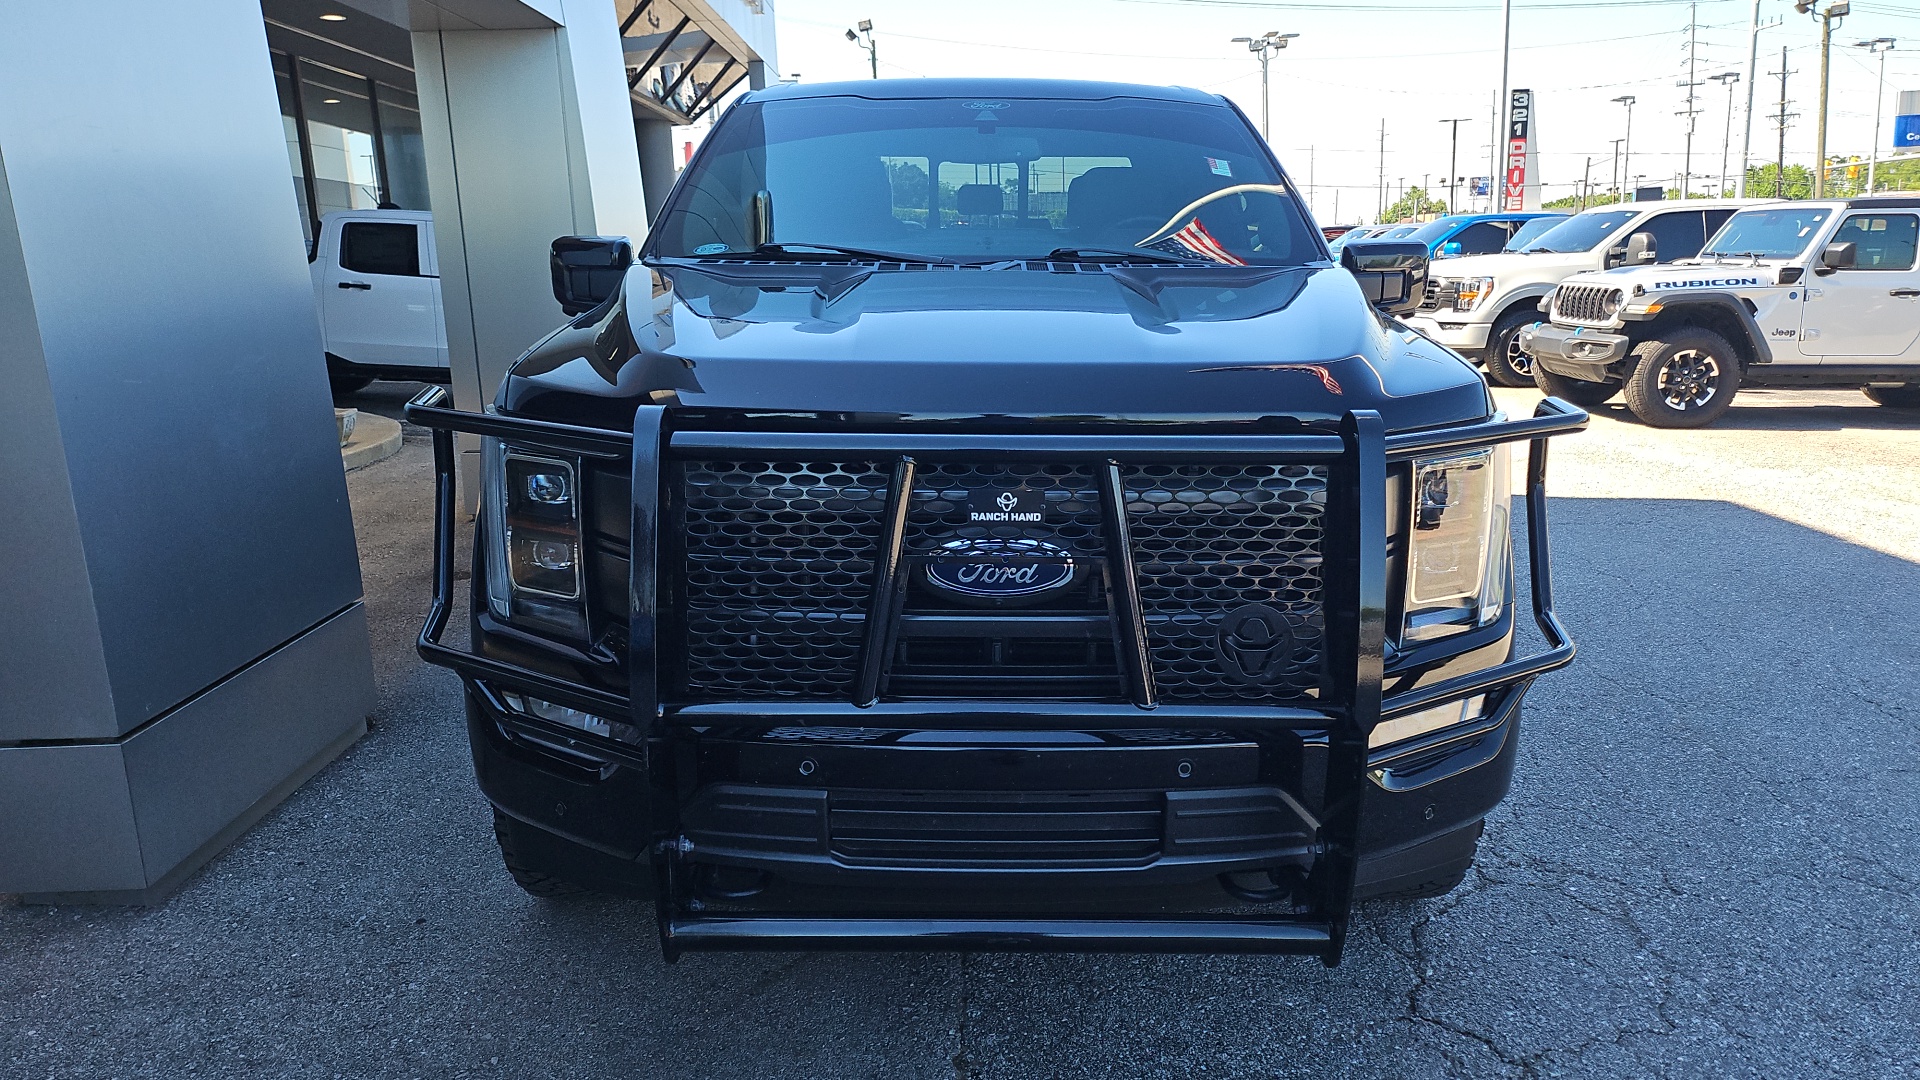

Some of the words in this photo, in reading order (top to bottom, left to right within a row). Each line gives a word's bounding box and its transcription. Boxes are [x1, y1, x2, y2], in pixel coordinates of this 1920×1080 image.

[970, 101, 1002, 109] Ford
[1512, 93, 1529, 136] 321
[1508, 141, 1526, 210] DRIVE
[1655, 278, 1757, 289] RUBICON
[1771, 328, 1796, 338] Jeep
[970, 512, 1009, 522] RANCH
[1010, 512, 1042, 522] HAND
[957, 557, 1039, 584] Ford
